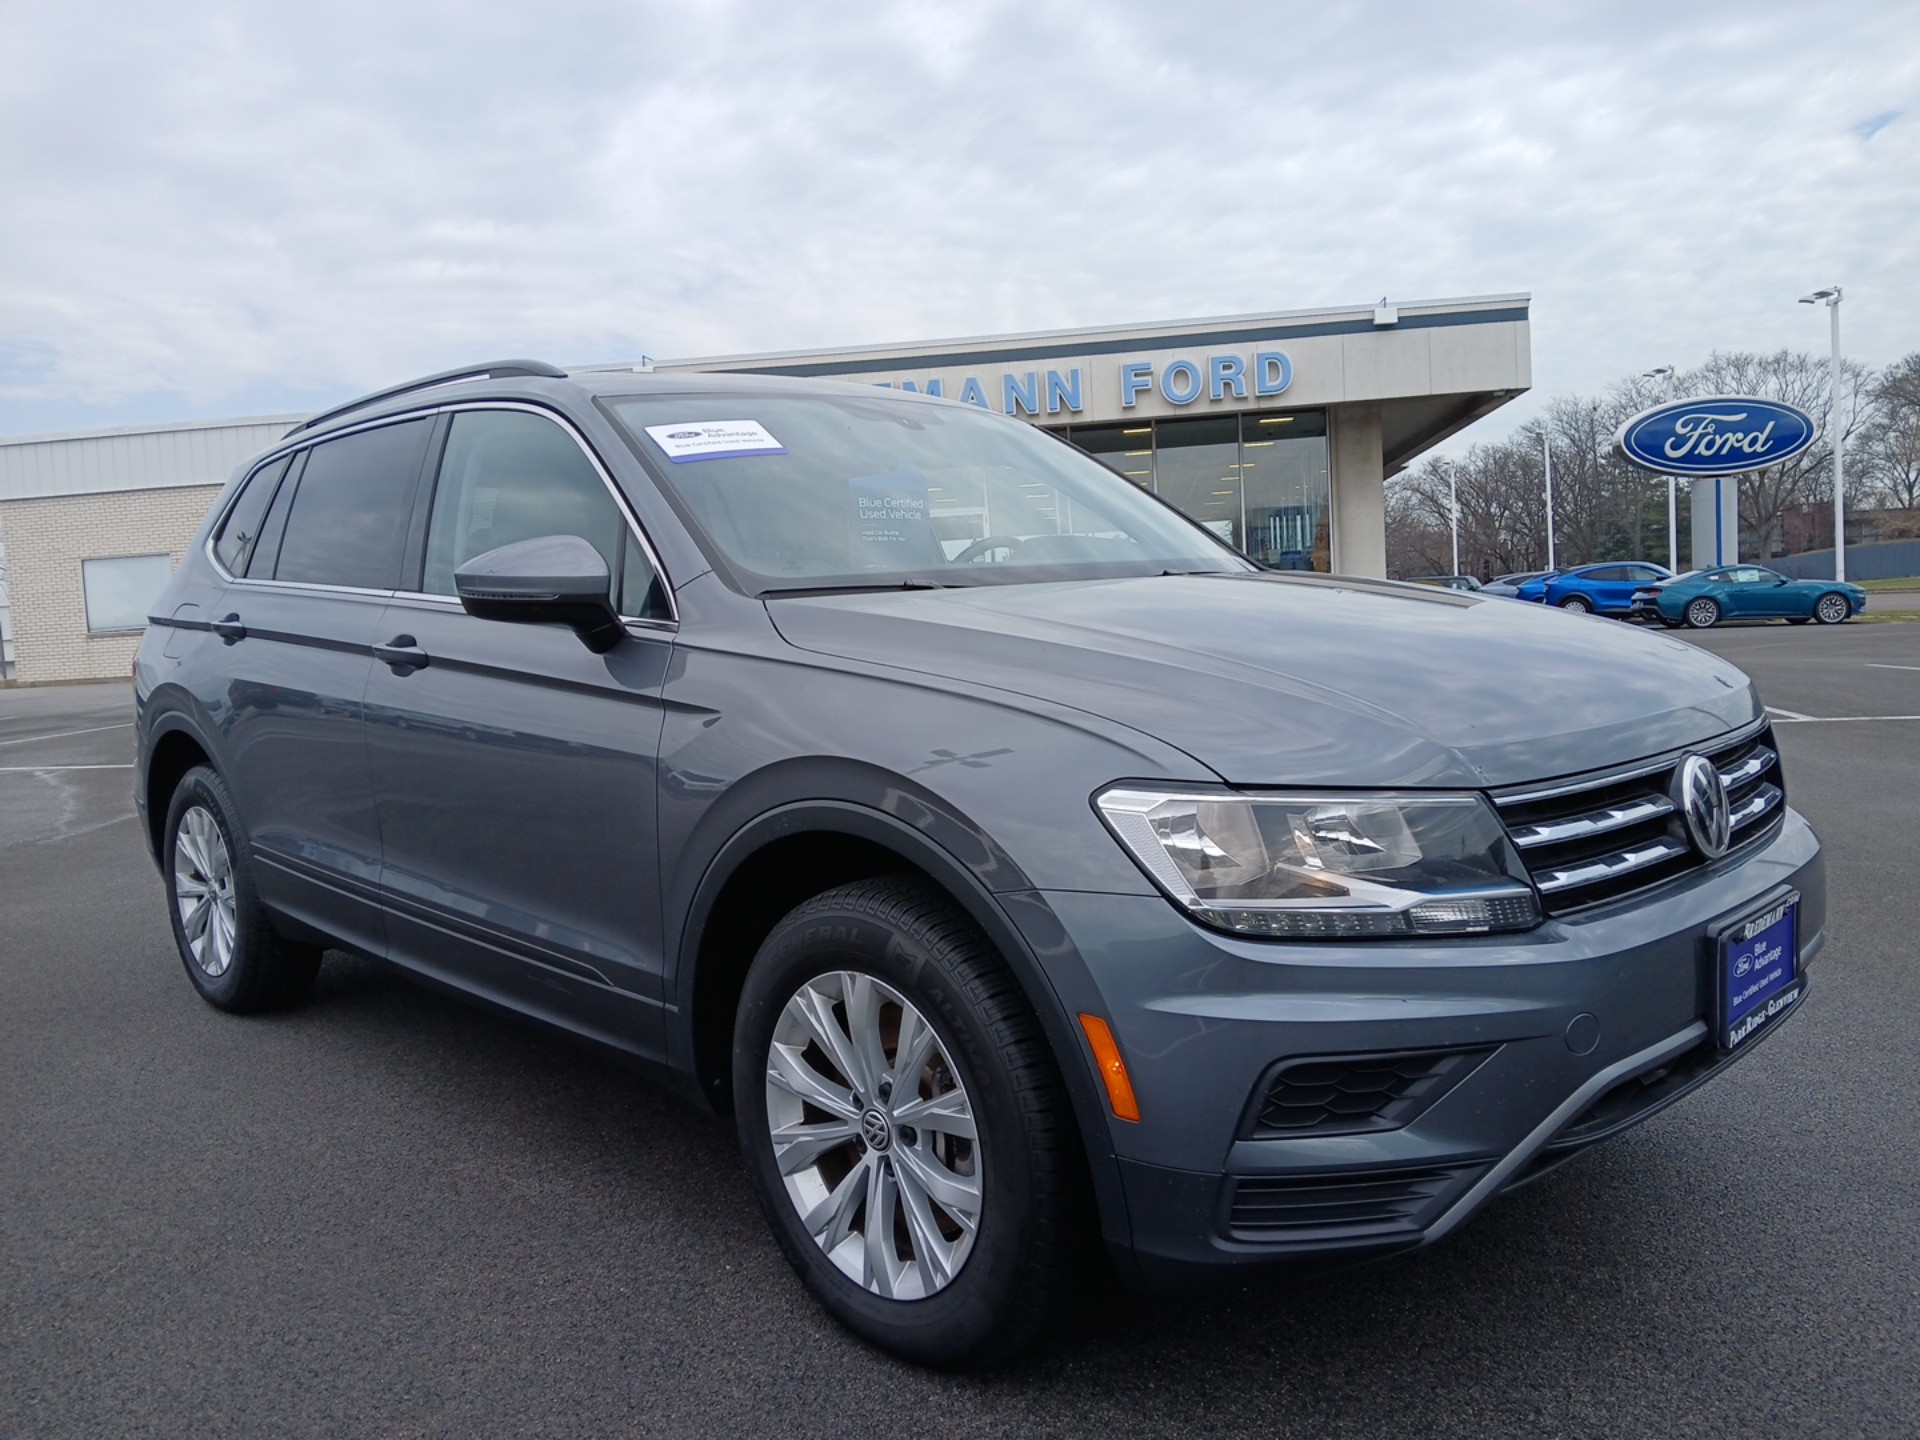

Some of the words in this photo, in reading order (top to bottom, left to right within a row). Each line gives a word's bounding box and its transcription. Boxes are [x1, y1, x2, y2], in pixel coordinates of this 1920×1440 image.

[871, 367, 1083, 415] ANN
[1120, 348, 1294, 408] FORD
[1663, 412, 1776, 459] Ford
[859, 496, 882, 508] Blue
[883, 496, 924, 509] Certified
[859, 509, 887, 519] Used
[887, 509, 922, 520] Vehicle
[1754, 941, 1767, 956] Blue
[1754, 946, 1782, 971] Advantage
